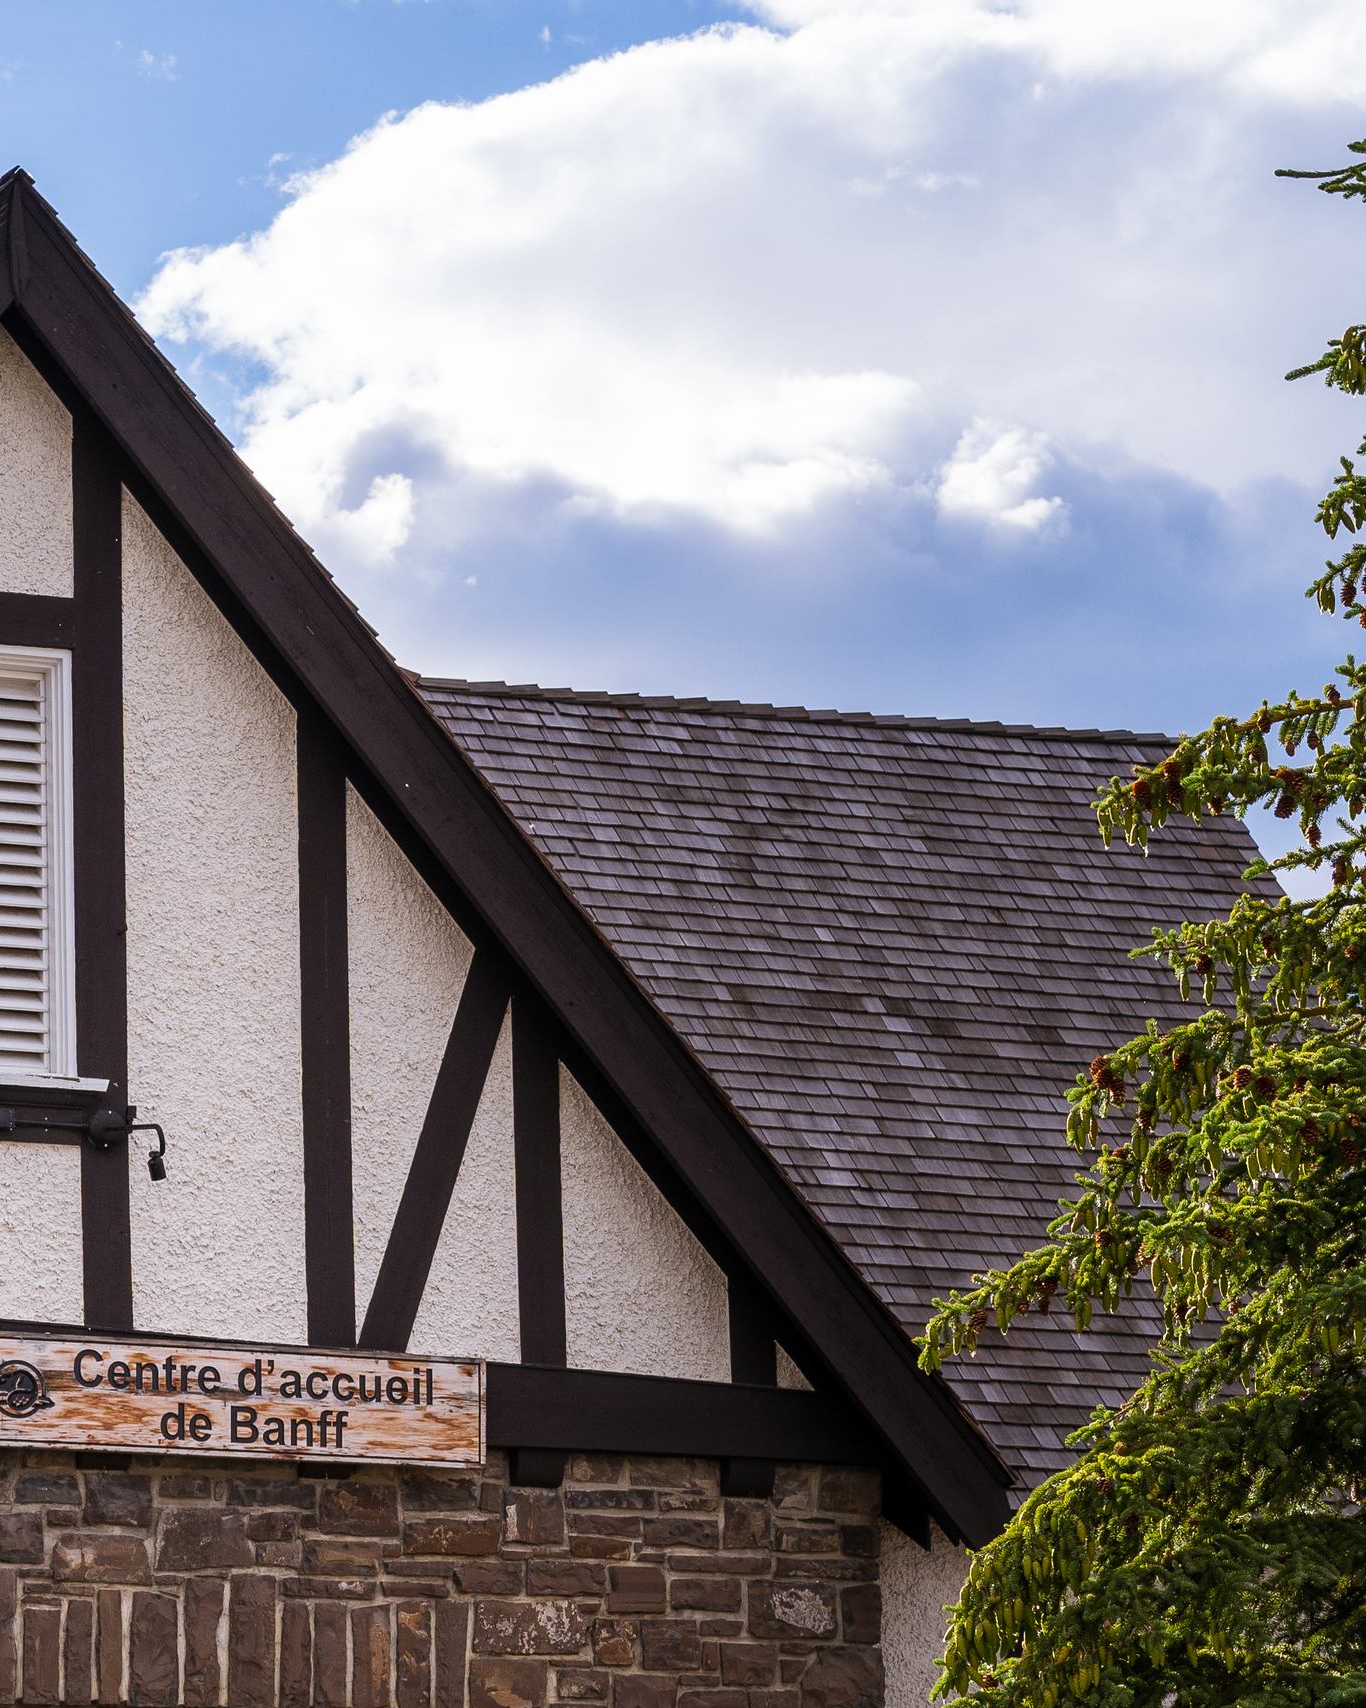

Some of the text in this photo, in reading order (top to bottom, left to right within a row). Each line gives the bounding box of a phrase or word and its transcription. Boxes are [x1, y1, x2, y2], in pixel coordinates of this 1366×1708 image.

[73, 1348, 434, 1406] Centre d'accueil
[160, 1402, 349, 1449] de Banff
